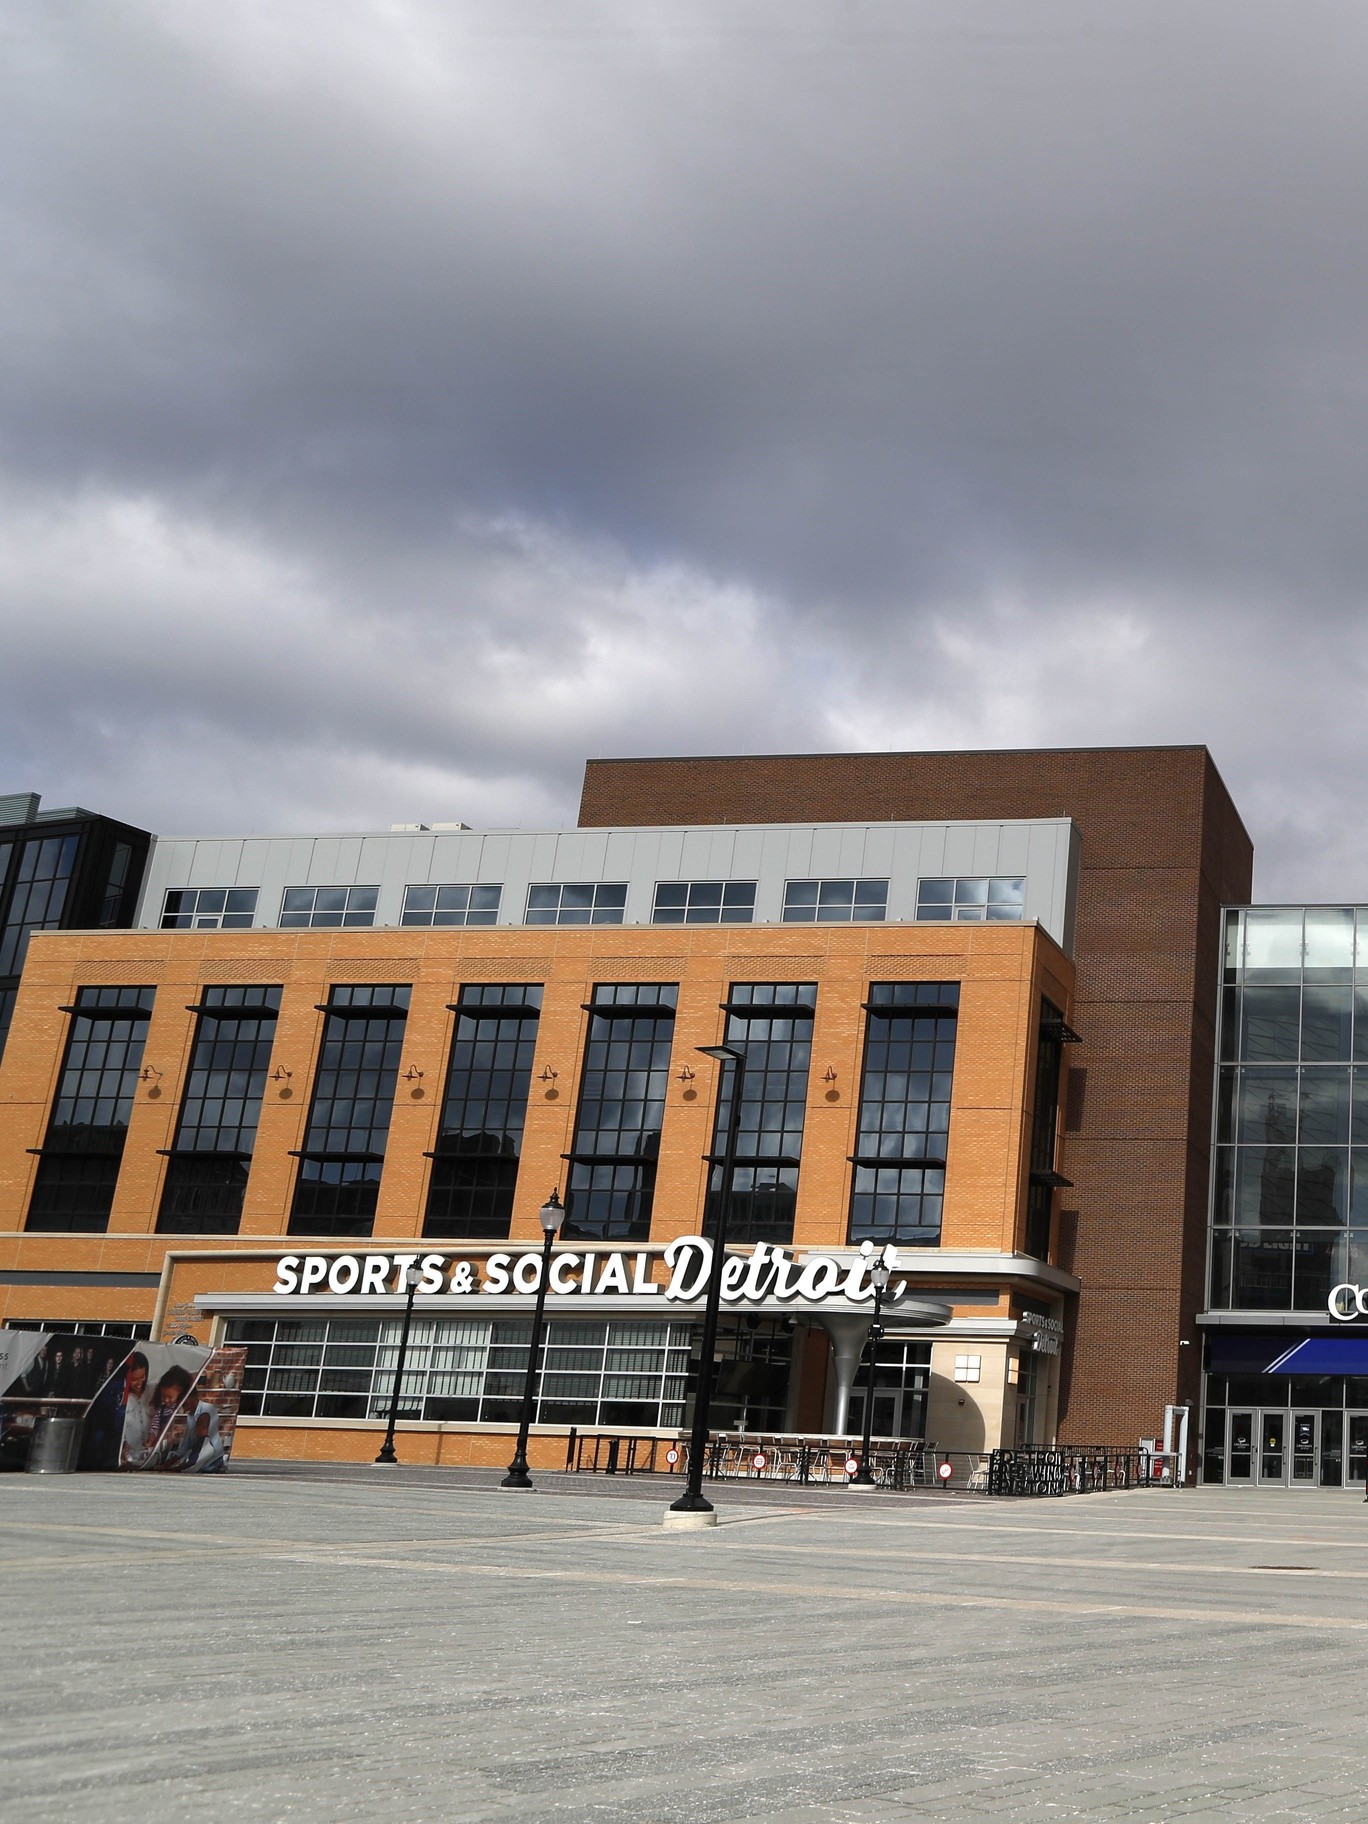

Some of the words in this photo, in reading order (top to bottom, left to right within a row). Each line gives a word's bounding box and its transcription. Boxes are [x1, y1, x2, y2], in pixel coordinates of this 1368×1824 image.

[272, 1254, 447, 1295] SPORTS
[450, 1261, 474, 1294] &
[482, 1253, 659, 1295] SOCIAL
[664, 1235, 907, 1301] Detroit
